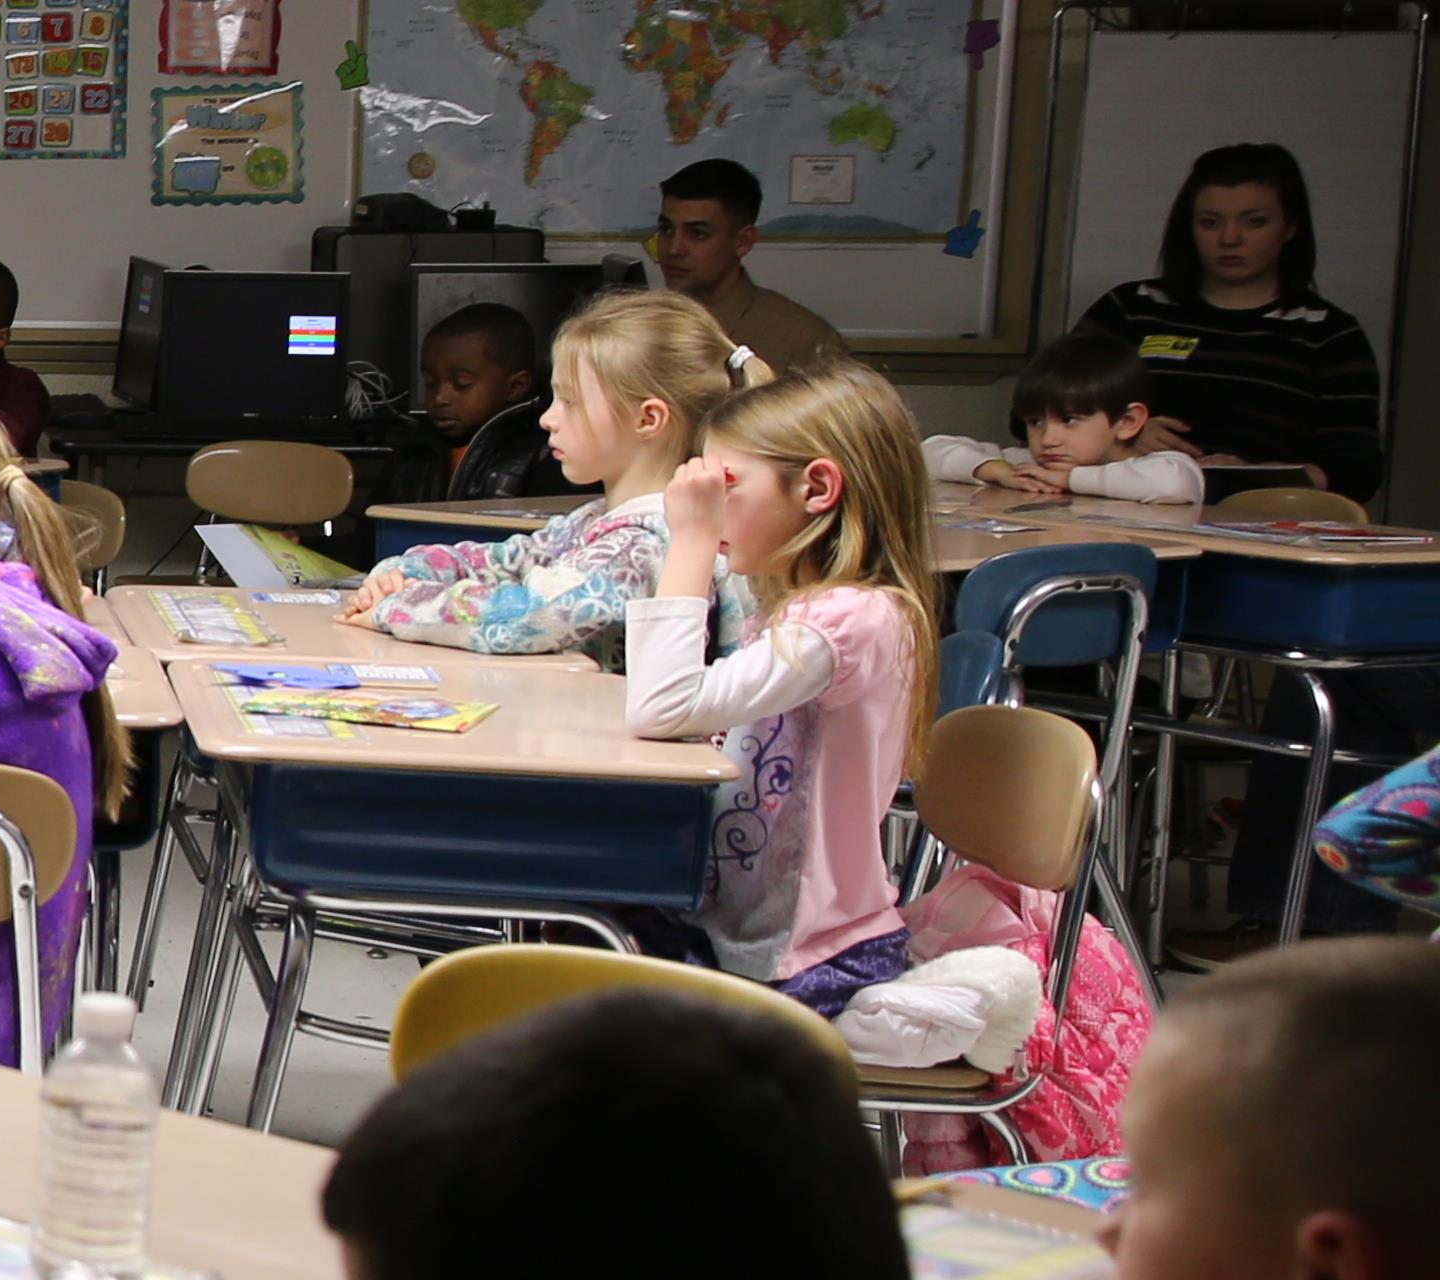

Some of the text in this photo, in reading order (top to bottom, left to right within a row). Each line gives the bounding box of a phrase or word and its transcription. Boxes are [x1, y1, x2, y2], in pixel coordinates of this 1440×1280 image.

[19, 21, 33, 39] 6
[50, 18, 65, 37] 7
[89, 16, 104, 36] 8
[48, 92, 71, 109] 21
[85, 90, 108, 109] 22
[8, 126, 32, 145] 27
